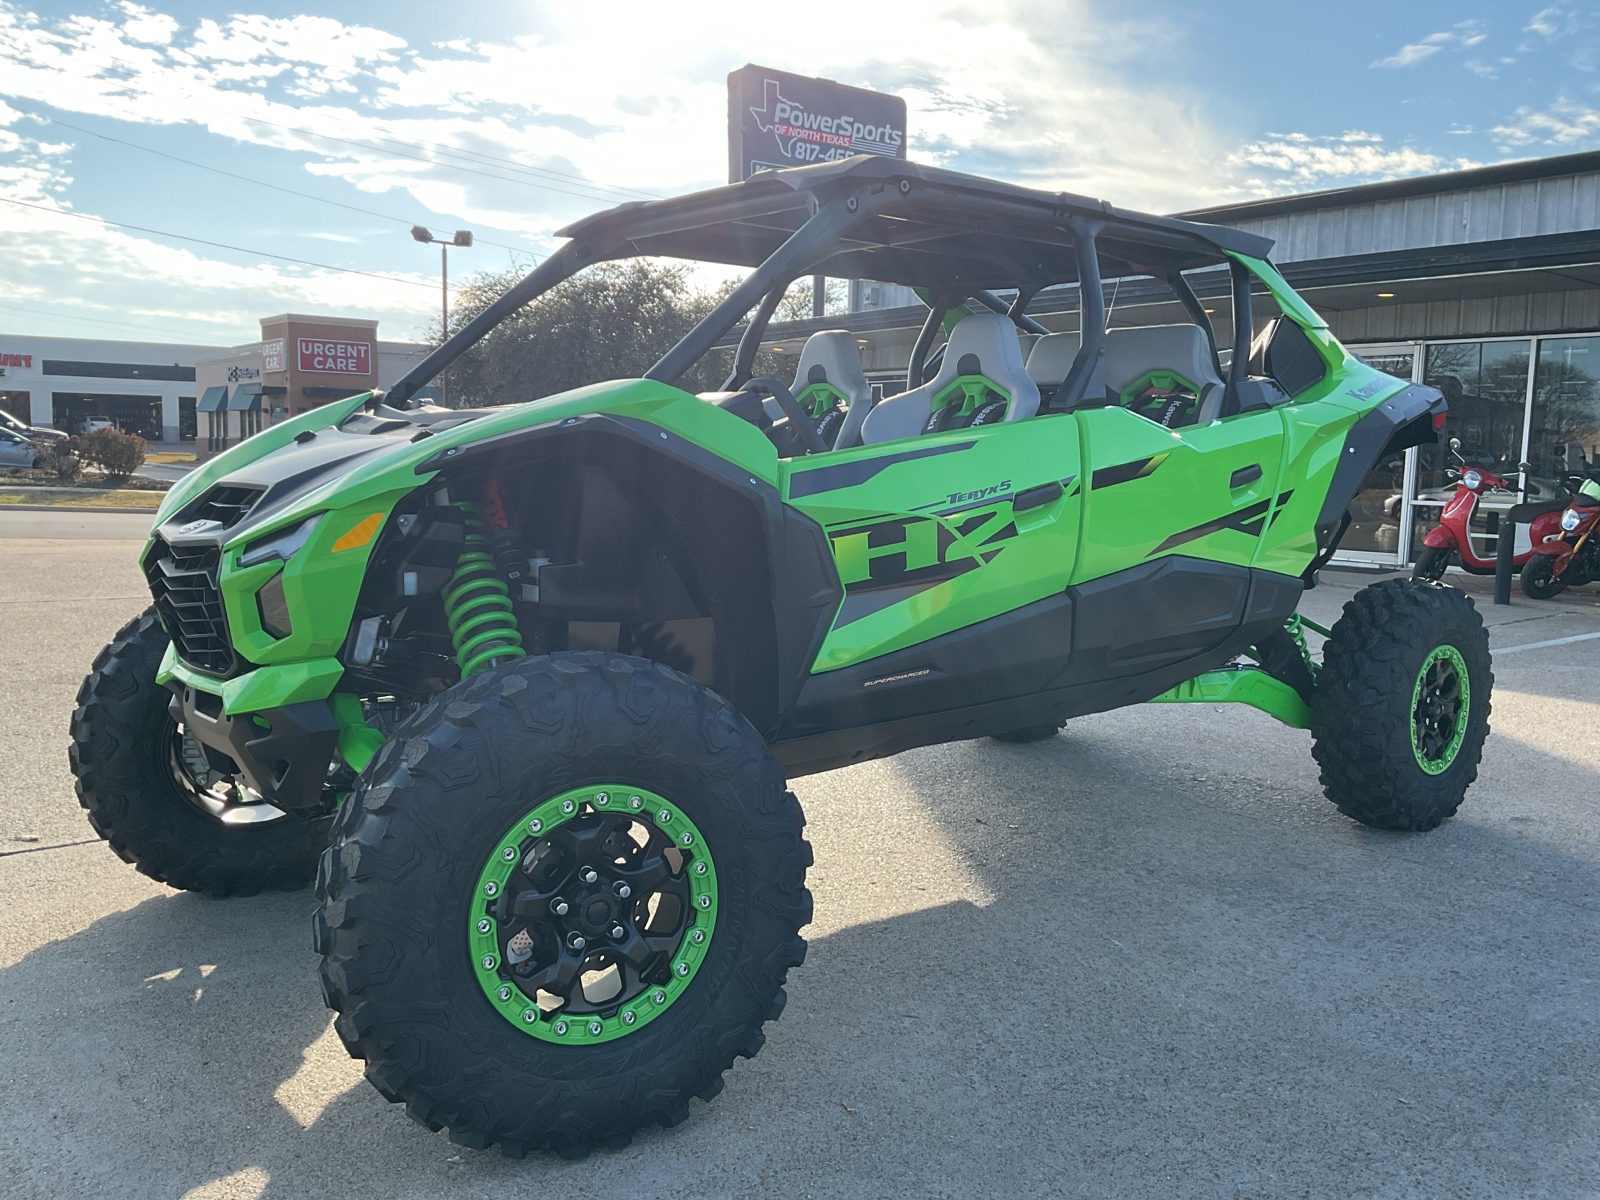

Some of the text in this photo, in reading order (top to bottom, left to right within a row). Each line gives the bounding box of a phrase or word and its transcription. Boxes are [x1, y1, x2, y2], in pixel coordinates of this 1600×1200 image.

[774, 103, 902, 146] PowerSports
[775, 125, 850, 147] OF NORTH TEXAS
[301, 342, 367, 358] URGENT
[266, 357, 280, 369] CARE
[313, 357, 357, 371] CARE
[863, 669, 930, 687] SUPERCHARGED
